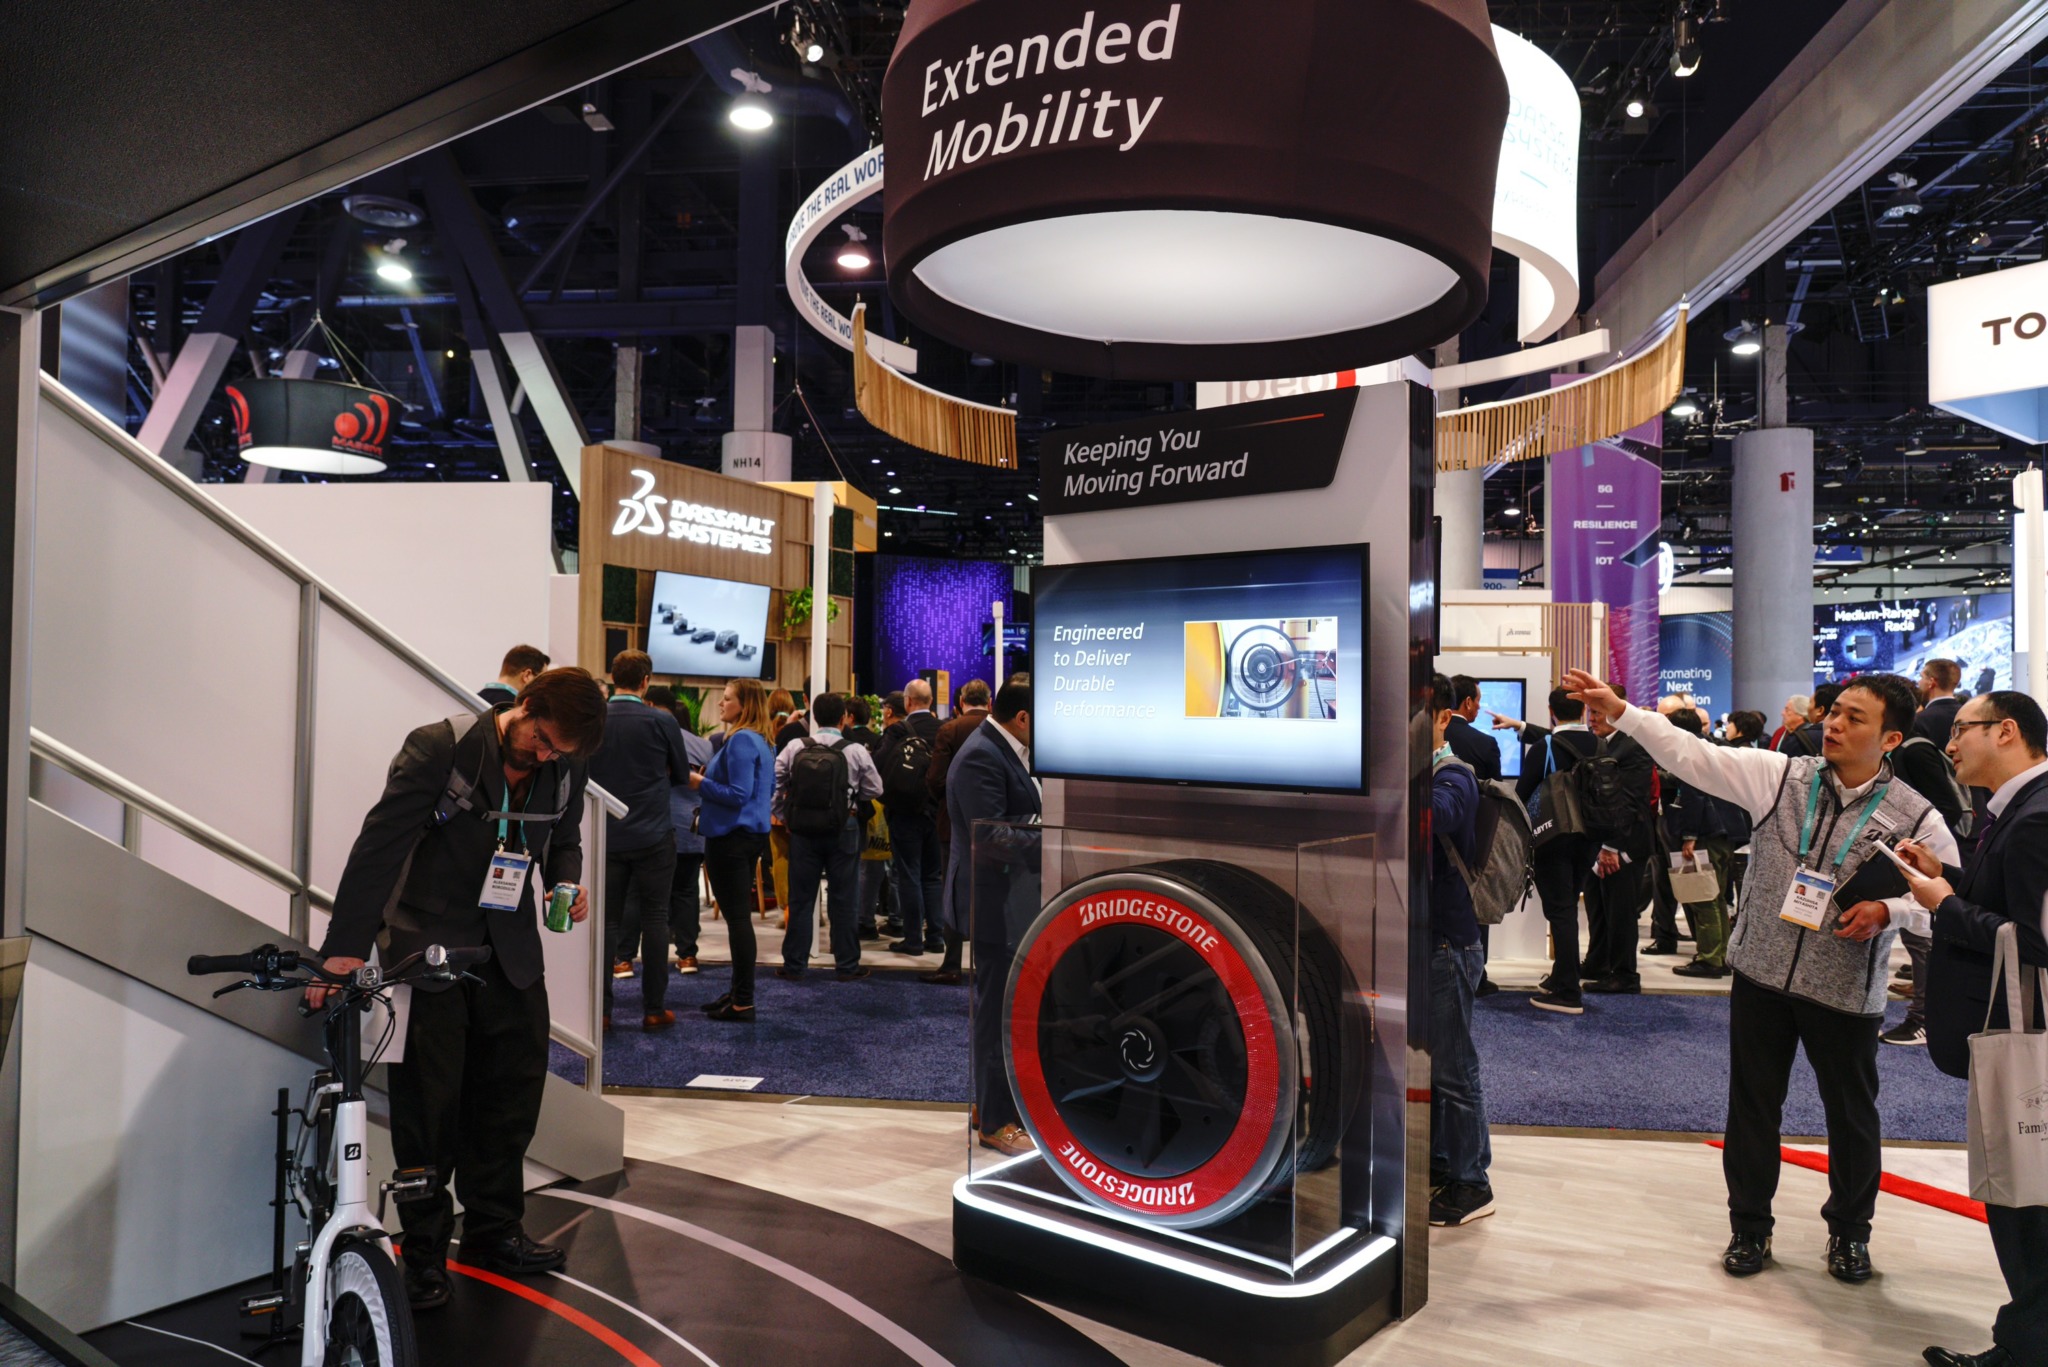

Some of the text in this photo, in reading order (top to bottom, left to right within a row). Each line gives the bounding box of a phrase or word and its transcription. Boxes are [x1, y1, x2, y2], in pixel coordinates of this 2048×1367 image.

[921, 3, 1181, 118] Extended
[923, 87, 1164, 181] Mobility
[806, 194, 822, 222] THE
[824, 173, 851, 206] REAL
[853, 153, 884, 185] WOR
[820, 305, 837, 331] REAL
[1063, 429, 1201, 467] Keeping You
[732, 456, 762, 469] NH14
[1063, 452, 1249, 497] Moving Forward
[1597, 484, 1613, 494] 5G
[669, 500, 776, 537] DASSAULT
[1573, 520, 1638, 530] RESILIENCE
[667, 521, 773, 555] SYSTEMES
[1595, 556, 1614, 566] IOT
[1834, 607, 1920, 622] Medium-Range
[1053, 622, 1144, 645] Engineered
[1053, 649, 1132, 667] to Deliver
[1053, 675, 1116, 693] Durable
[1658, 667, 1712, 681] utomating
[1666, 681, 1693, 692] Next
[1053, 700, 1156, 719] Performance
[1080, 898, 1218, 953] BRIDGESTONE
[1059, 1141, 1196, 1206] BRIDGESTONE
